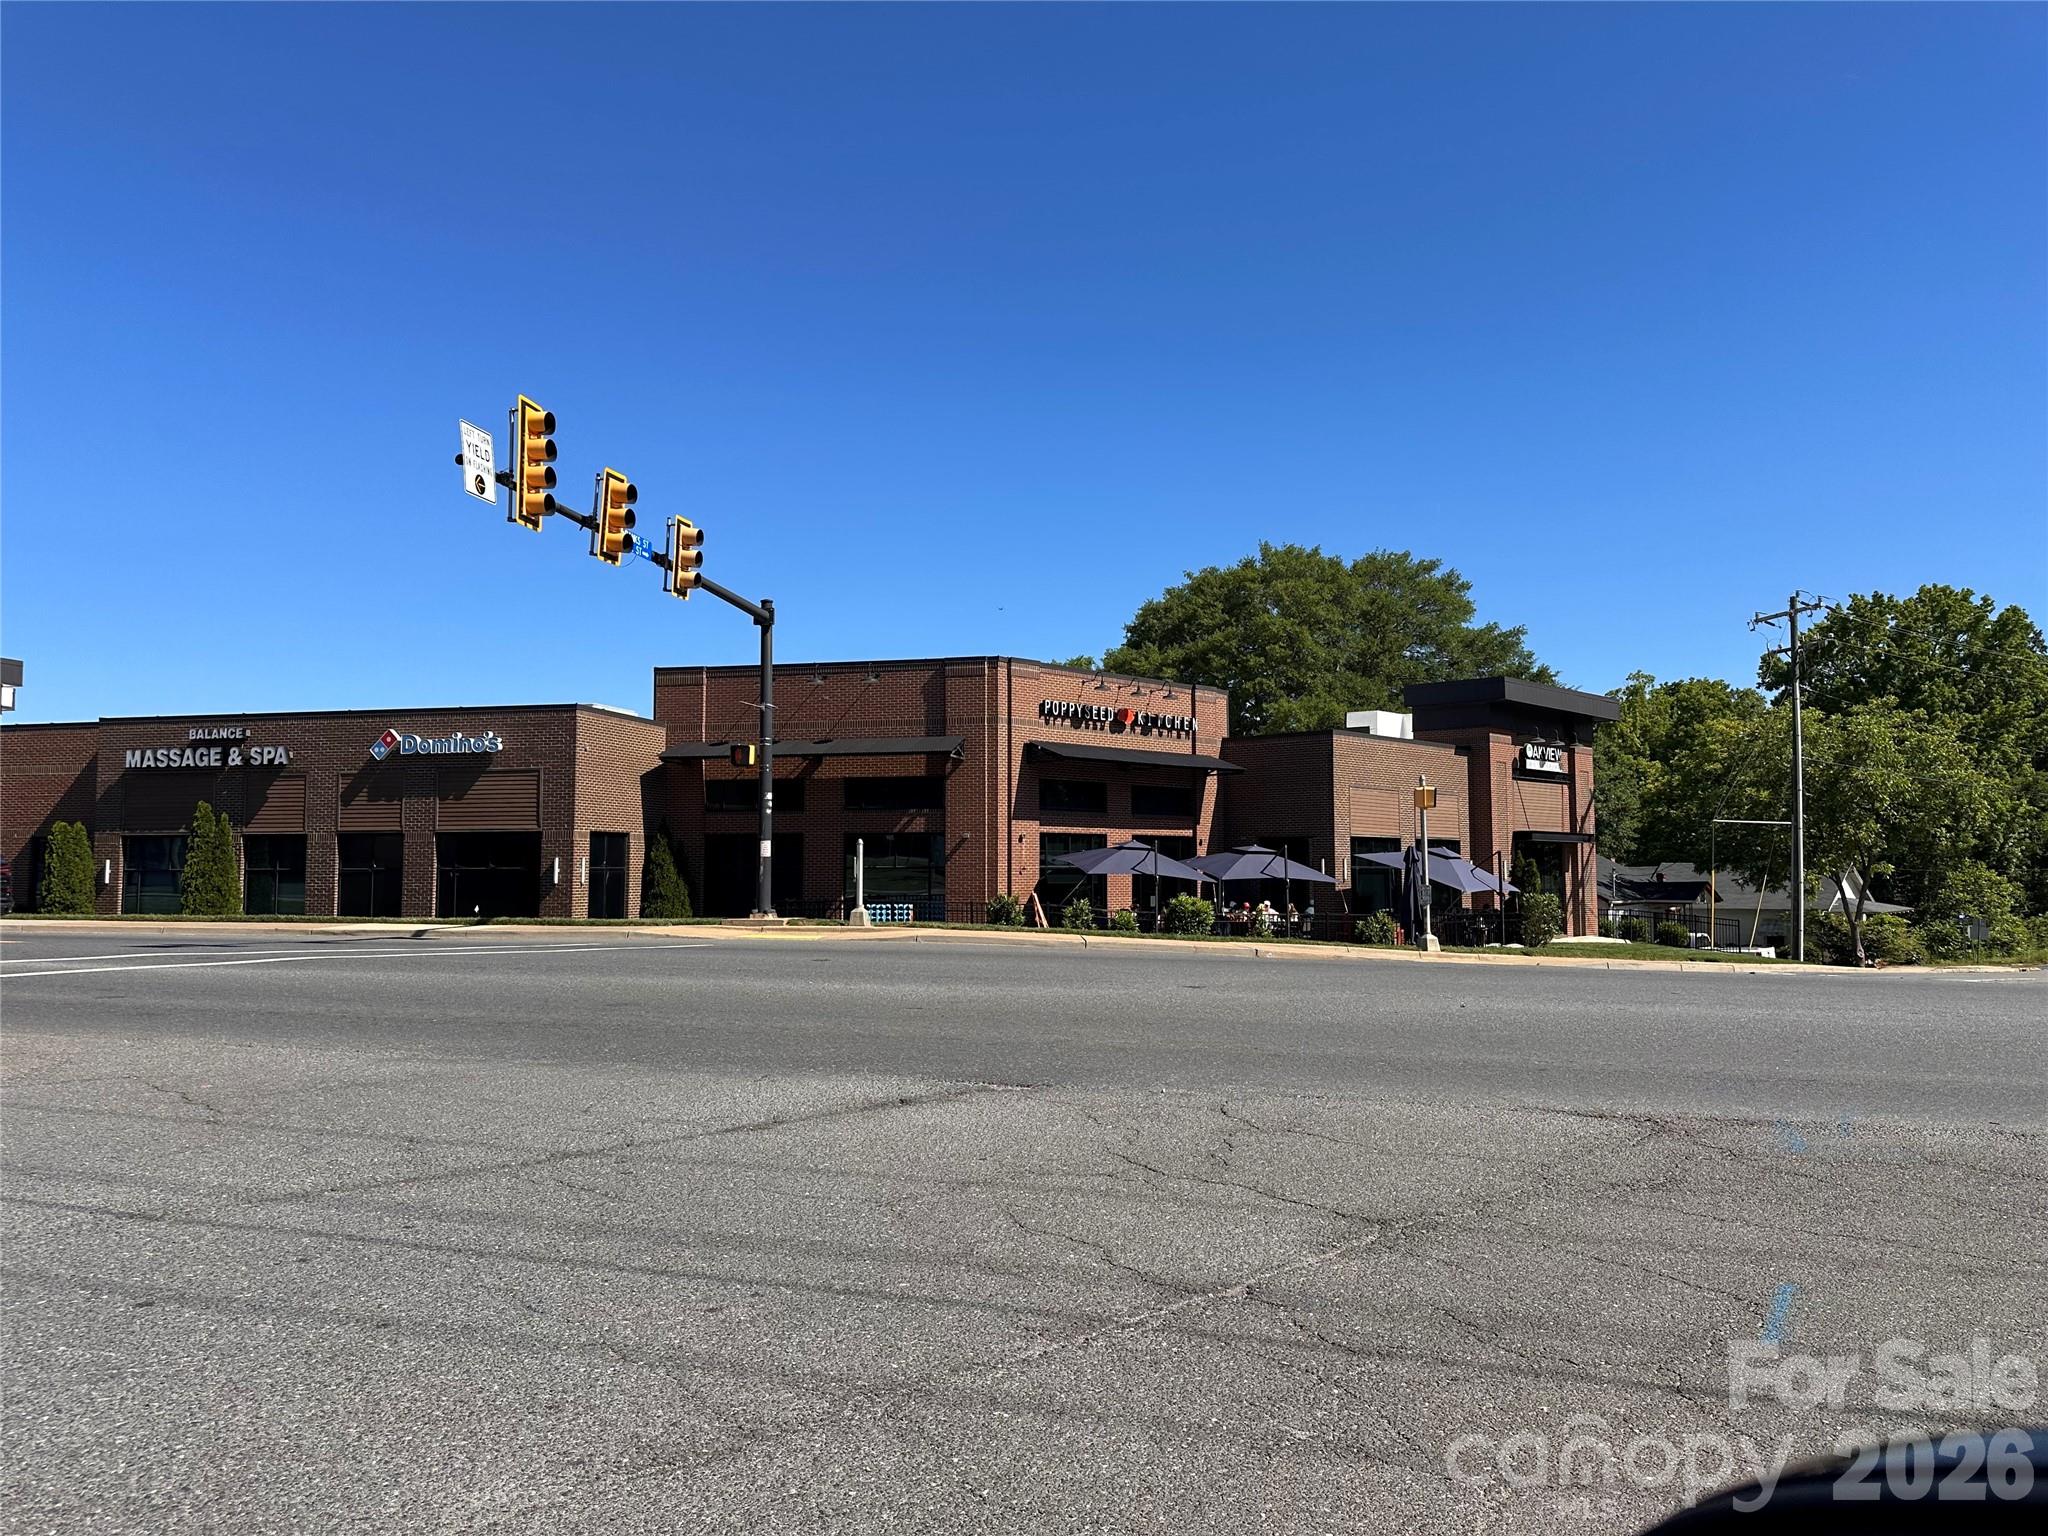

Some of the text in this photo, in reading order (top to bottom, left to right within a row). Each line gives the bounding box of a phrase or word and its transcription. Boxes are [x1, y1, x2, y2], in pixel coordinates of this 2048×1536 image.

[466, 439, 490, 463] YIELD
[1044, 699, 1199, 732] POPPYSEED KITCHEN
[189, 727, 244, 740] BALANCE
[400, 731, 501, 755] Domino's
[125, 746, 289, 768] MASSAGE & SPA
